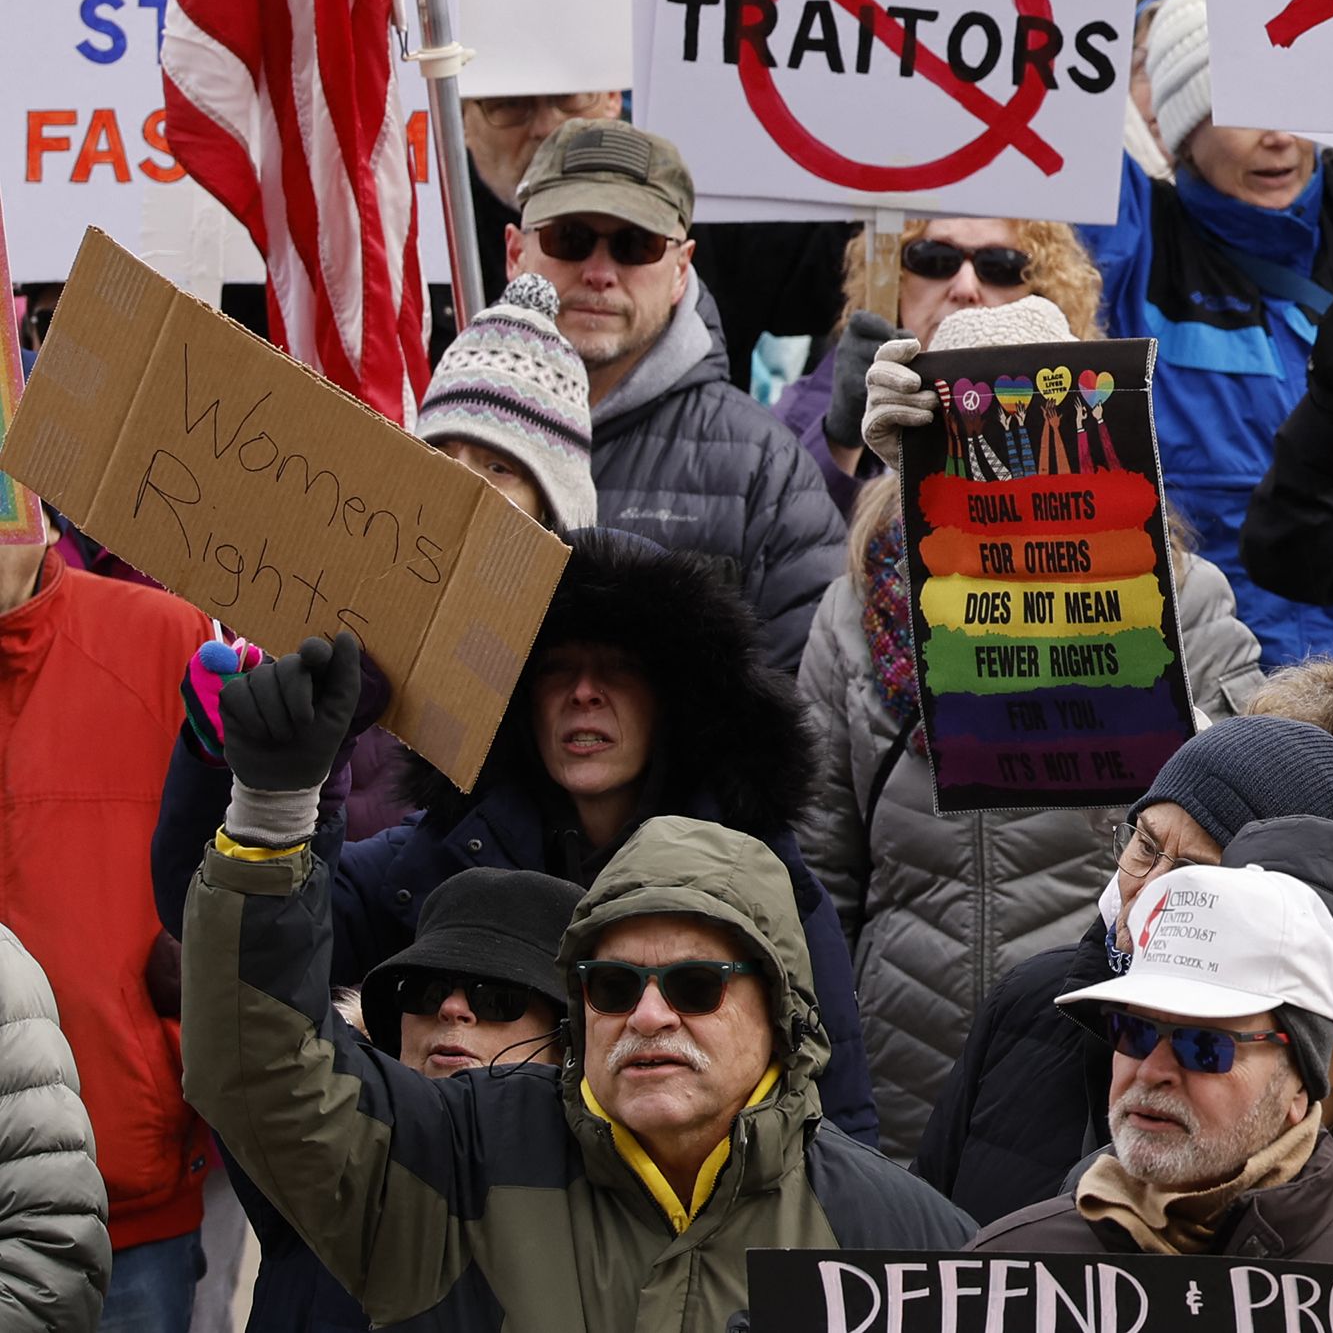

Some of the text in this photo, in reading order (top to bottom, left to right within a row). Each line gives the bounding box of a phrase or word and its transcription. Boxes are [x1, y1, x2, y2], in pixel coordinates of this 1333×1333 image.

[1045, 380, 1063, 388] LIVES
[184, 343, 443, 585] Women's
[968, 490, 1095, 526] EQUAL RIGHTS
[979, 538, 1091, 575] FOR OTHERS
[964, 589, 1122, 625] DOES NOT MEAN
[975, 642, 1119, 678] FEWER RIGHTS
[1007, 703, 1049, 733] FOR
[1042, 751, 1084, 782] NOT
[1170, 890, 1219, 909] CHRIST
[1159, 926, 1217, 942] METHODIST
[1208, 961, 1219, 972] MI
